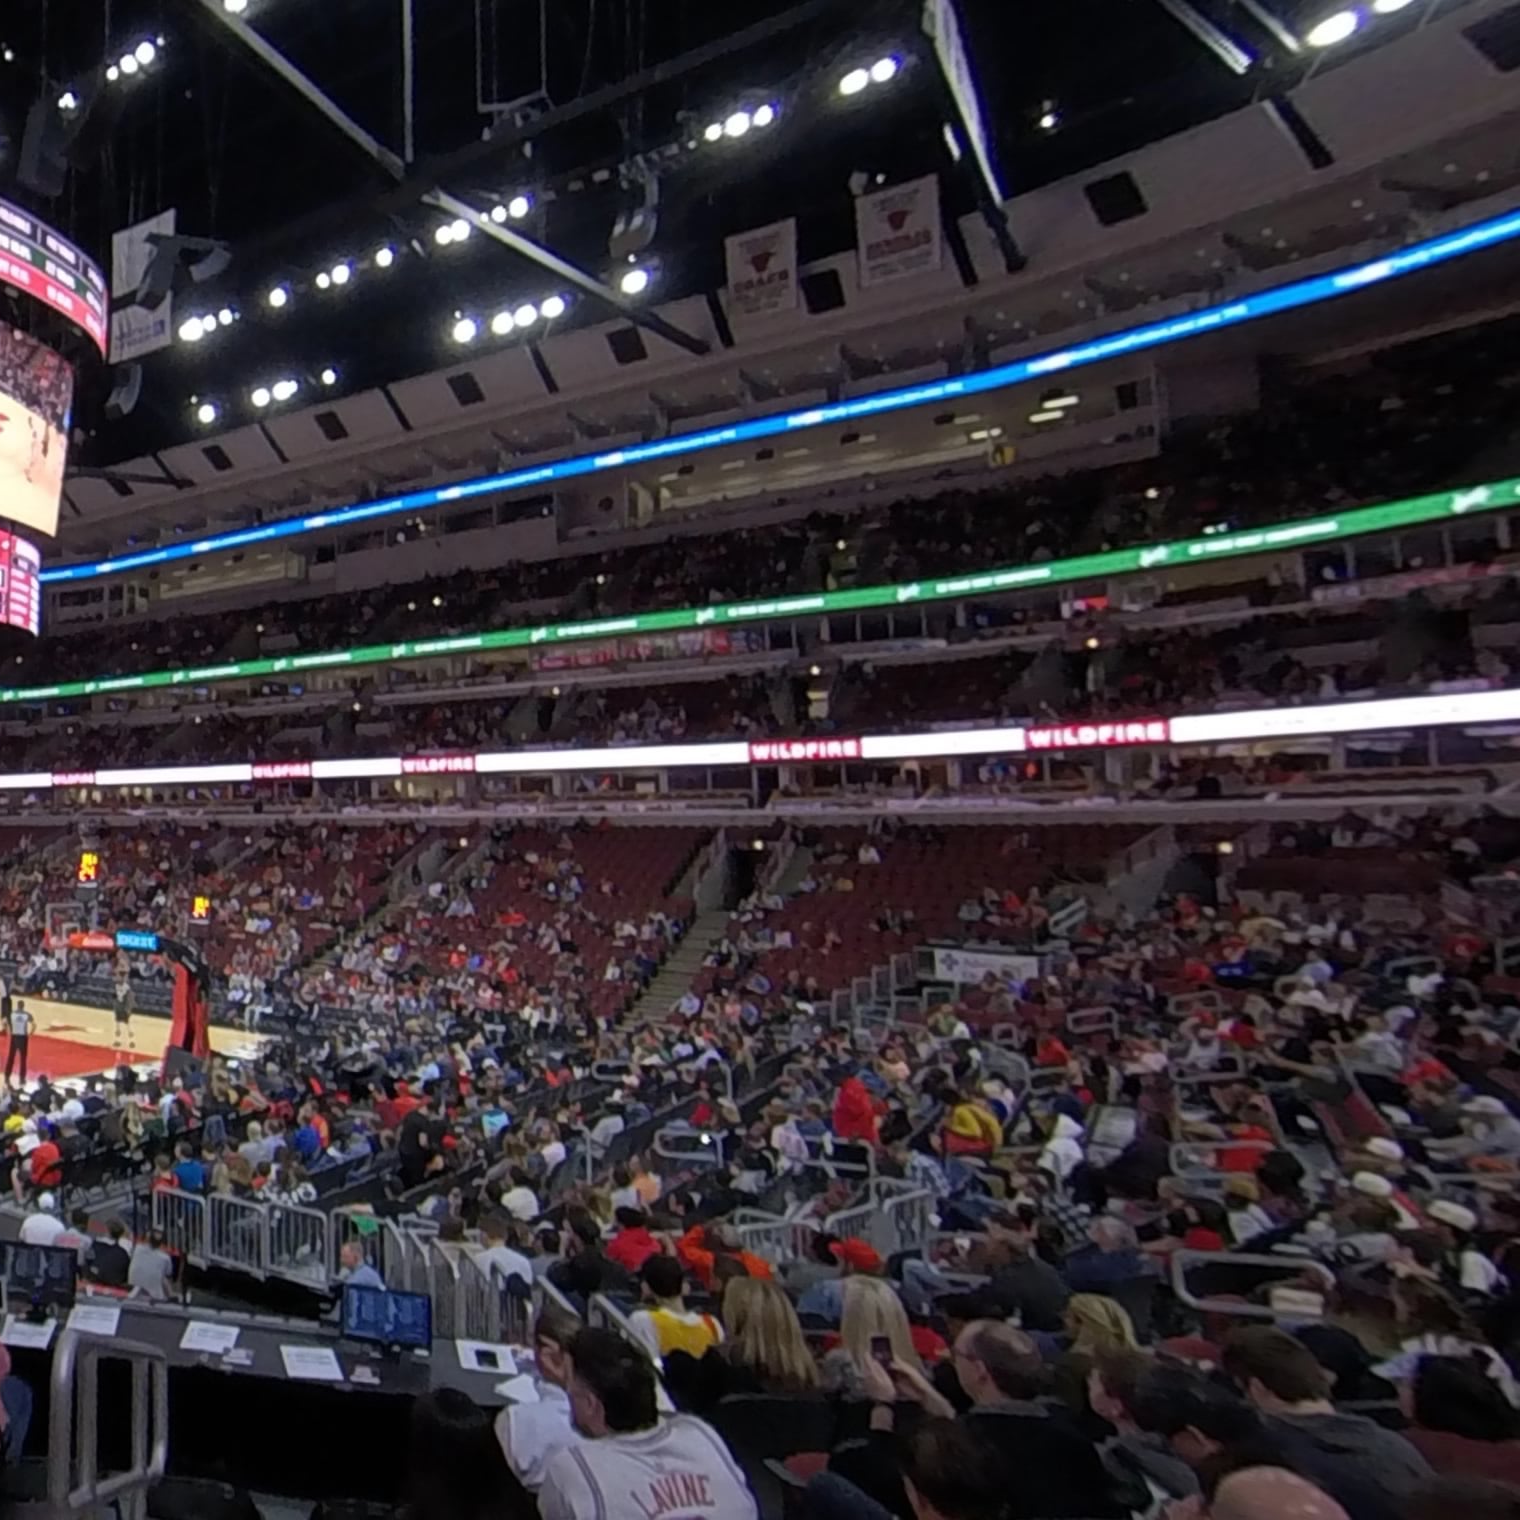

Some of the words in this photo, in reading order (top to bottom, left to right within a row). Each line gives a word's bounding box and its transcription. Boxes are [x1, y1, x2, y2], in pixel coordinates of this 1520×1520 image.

[1027, 721, 1166, 749] WILDFIRE
[750, 740, 858, 762] WILDFIRE
[403, 756, 474, 773] WILDFIRE
[629, 1470, 716, 1520] LAVINE
